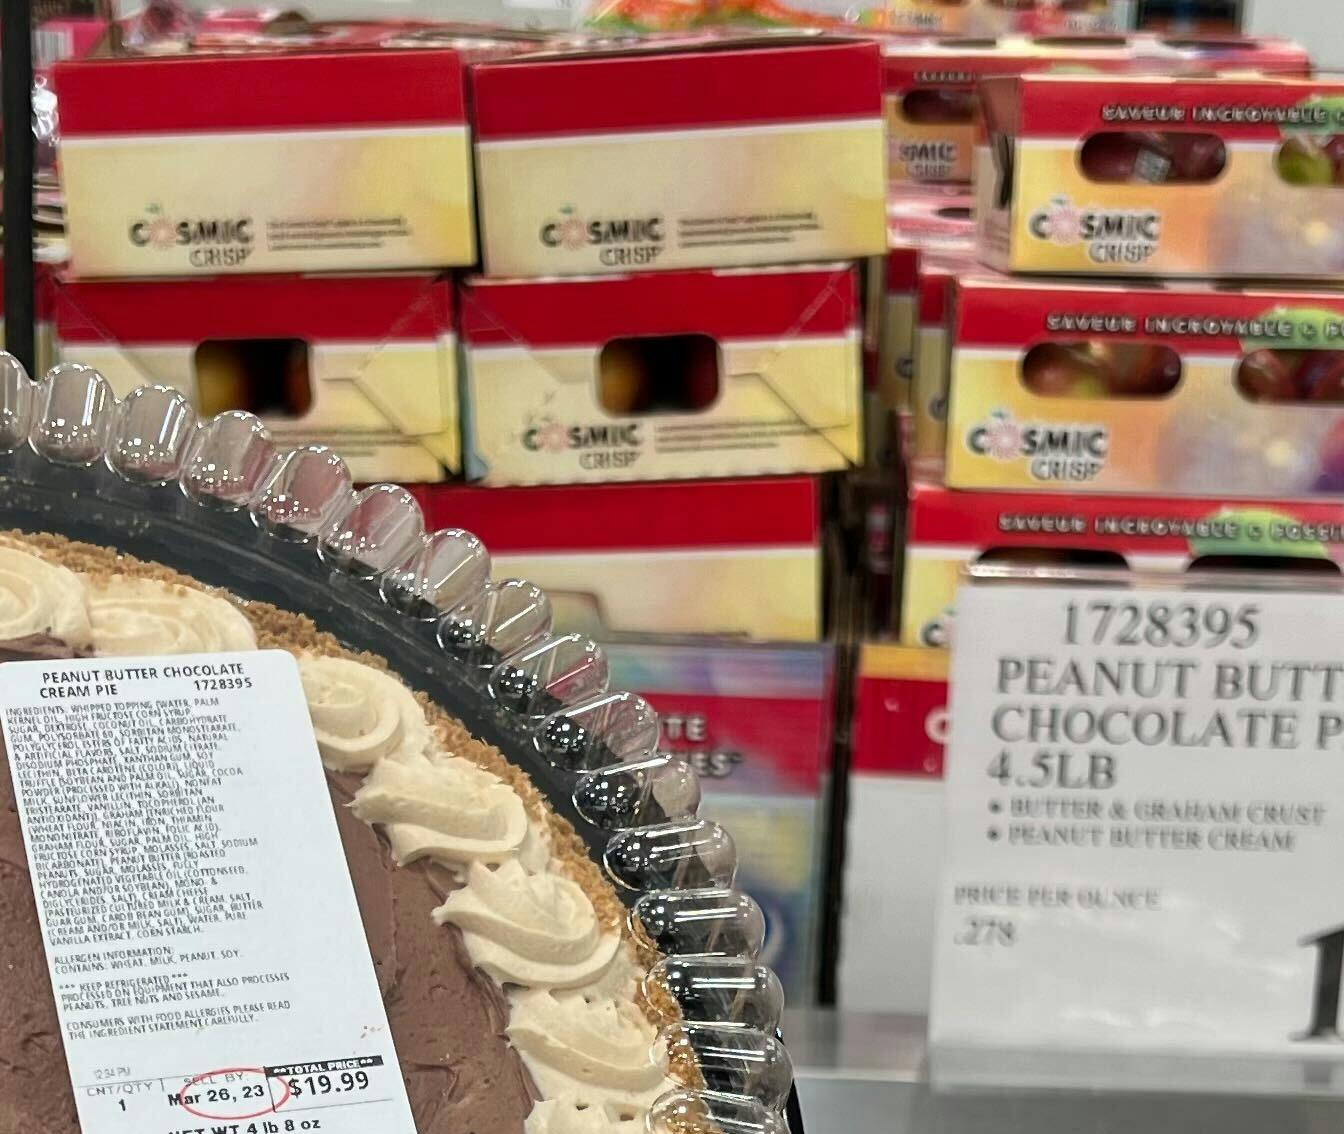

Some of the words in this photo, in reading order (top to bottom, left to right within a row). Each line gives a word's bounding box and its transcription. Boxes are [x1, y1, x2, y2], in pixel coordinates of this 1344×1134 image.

[129, 214, 254, 248] COSMIC
[540, 214, 665, 249] COSMIC
[1030, 206, 1161, 246] COSMIC
[1088, 240, 1160, 264] CRISP
[522, 422, 642, 452] COSMIC
[967, 421, 1108, 461] COSMIC
[1030, 457, 1103, 483] CRISP
[1063, 601, 1262, 649] 1728395
[41, 670, 101, 683] PEANUT
[104, 668, 158, 680] BUTTER
[162, 664, 245, 677] CHOCOLATE
[193, 677, 253, 690] 1728395
[996, 657, 1198, 699] PEANUT
[39, 686, 91, 698] CREAM
[94, 685, 118, 695] PIE
[193, 698, 219, 706] PALM
[990, 706, 1303, 749] CHOCOLATE
[987, 750, 1118, 790] 4.5LB
[1010, 799, 1103, 821] BUTTER
[1108, 801, 1128, 822] &
[1133, 801, 1241, 824] GRAHAM
[1246, 803, 1326, 826] CRUST
[1008, 826, 1103, 848] PEANUT
[1109, 827, 1203, 849] BUTTER
[1207, 830, 1296, 852] CREAM
[954, 886, 1022, 906] PRICE
[1027, 888, 1070, 908] PER
[1076, 889, 1161, 911] OUNCE
[954, 918, 1017, 947] .278
[53, 952, 101, 963] ALLERGEN
[60, 990, 113, 1002] PROCESSED
[113, 989, 131, 997] ON
[132, 983, 188, 994] EQUIPMENT
[190, 980, 214, 988] THAT
[215, 977, 239, 986] ALSO
[241, 973, 290, 983] PROCESSES
[79, 982, 103, 991] KEEP
[104, 975, 170, 988] REFRIGERATED
[110, 998, 132, 1006] TREE
[134, 995, 159, 1004] NUTS
[161, 992, 183, 1001] AND
[66, 1017, 125, 1030] CONSUMERS
[127, 1014, 153, 1024] WITH
[154, 1011, 181, 1021] FOOD
[183, 1006, 231, 1018] ALLERGIES
[232, 1003, 264, 1013] PLEASE
[266, 1000, 291, 1009] READ
[68, 1030, 85, 1039] THE
[88, 1025, 146, 1037] INGREDIENT
[147, 1019, 203, 1031] STATEMENT
[86, 1081, 154, 1096] CNT/QTY
[167, 1091, 202, 1106] Mar
[206, 1088, 237, 1104] 26,
[241, 1085, 265, 1098] 23
[286, 1071, 371, 1097] $19.99
[117, 1100, 126, 1110] 1
[245, 1123, 259, 1134] 4
[262, 1121, 280, 1133] lb
[283, 1119, 295, 1131] 8
[299, 1119, 321, 1129] oz
